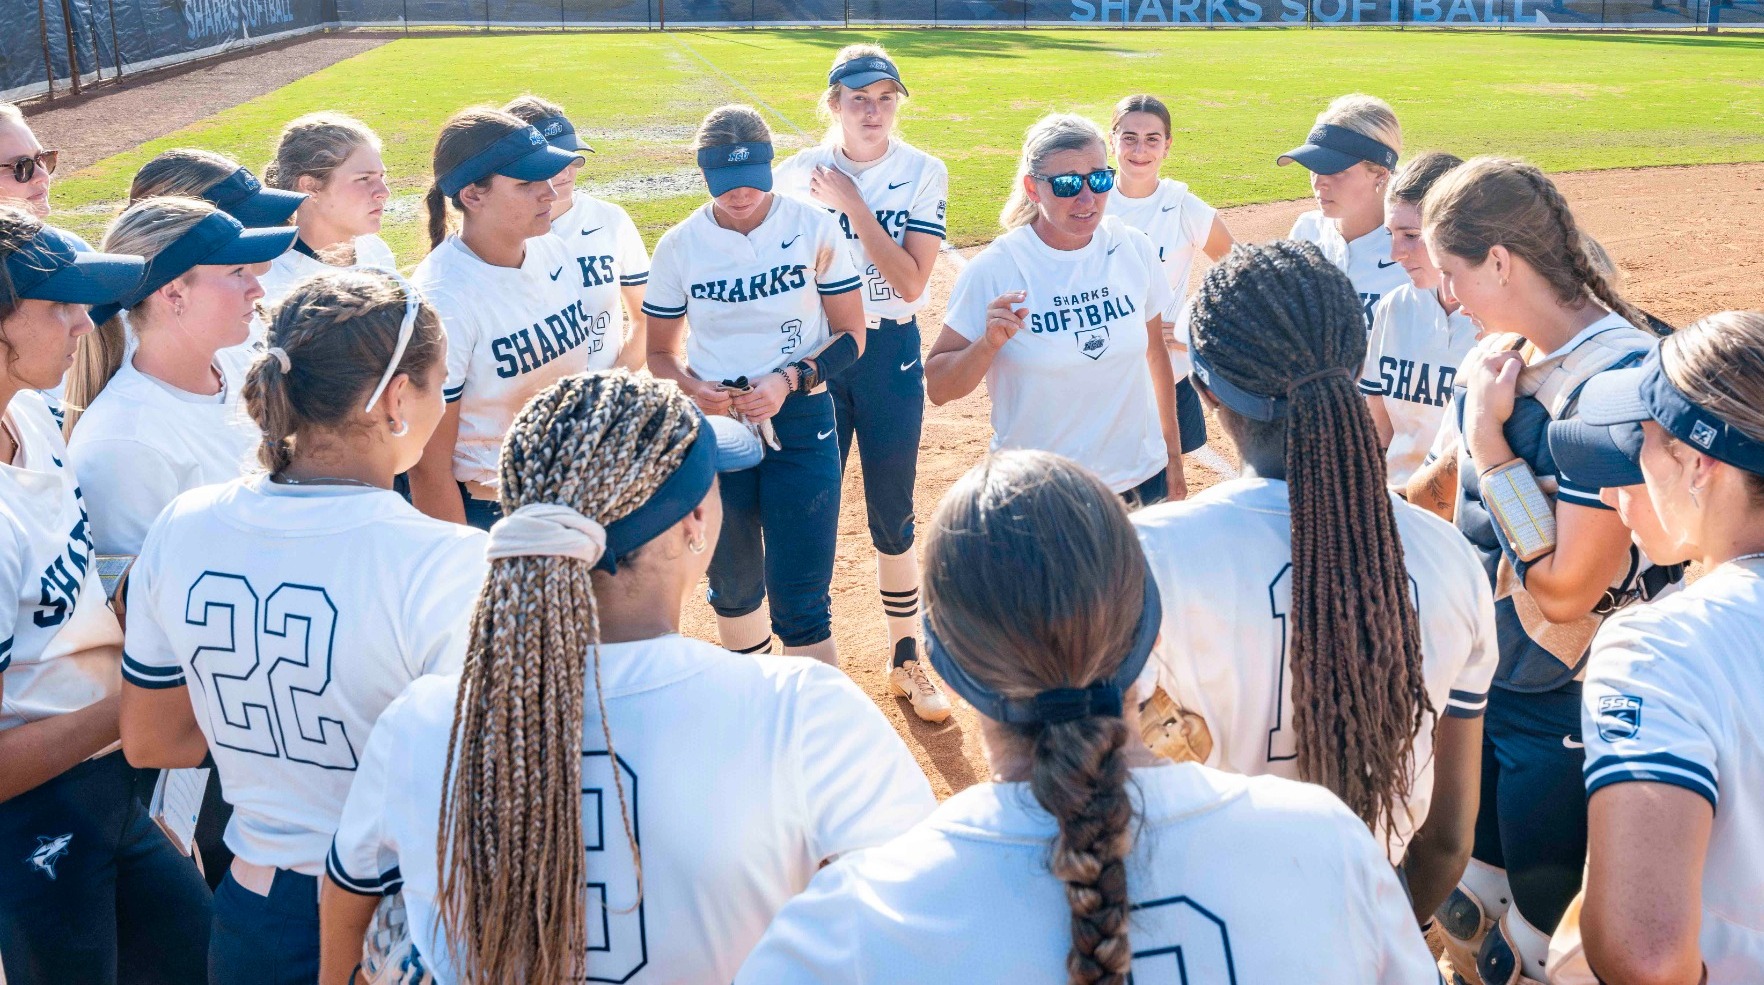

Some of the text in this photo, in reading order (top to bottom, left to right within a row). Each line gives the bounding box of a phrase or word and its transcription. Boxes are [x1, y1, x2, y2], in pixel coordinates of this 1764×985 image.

[1070, 0, 1537, 23] SHARKS SOFTBALL
[1031, 295, 1136, 333] SOFTBALL
[1053, 286, 1109, 307] SHARKS
[781, 318, 803, 355] 3
[1379, 355, 1458, 408] SHAR
[185, 570, 359, 771] 22
